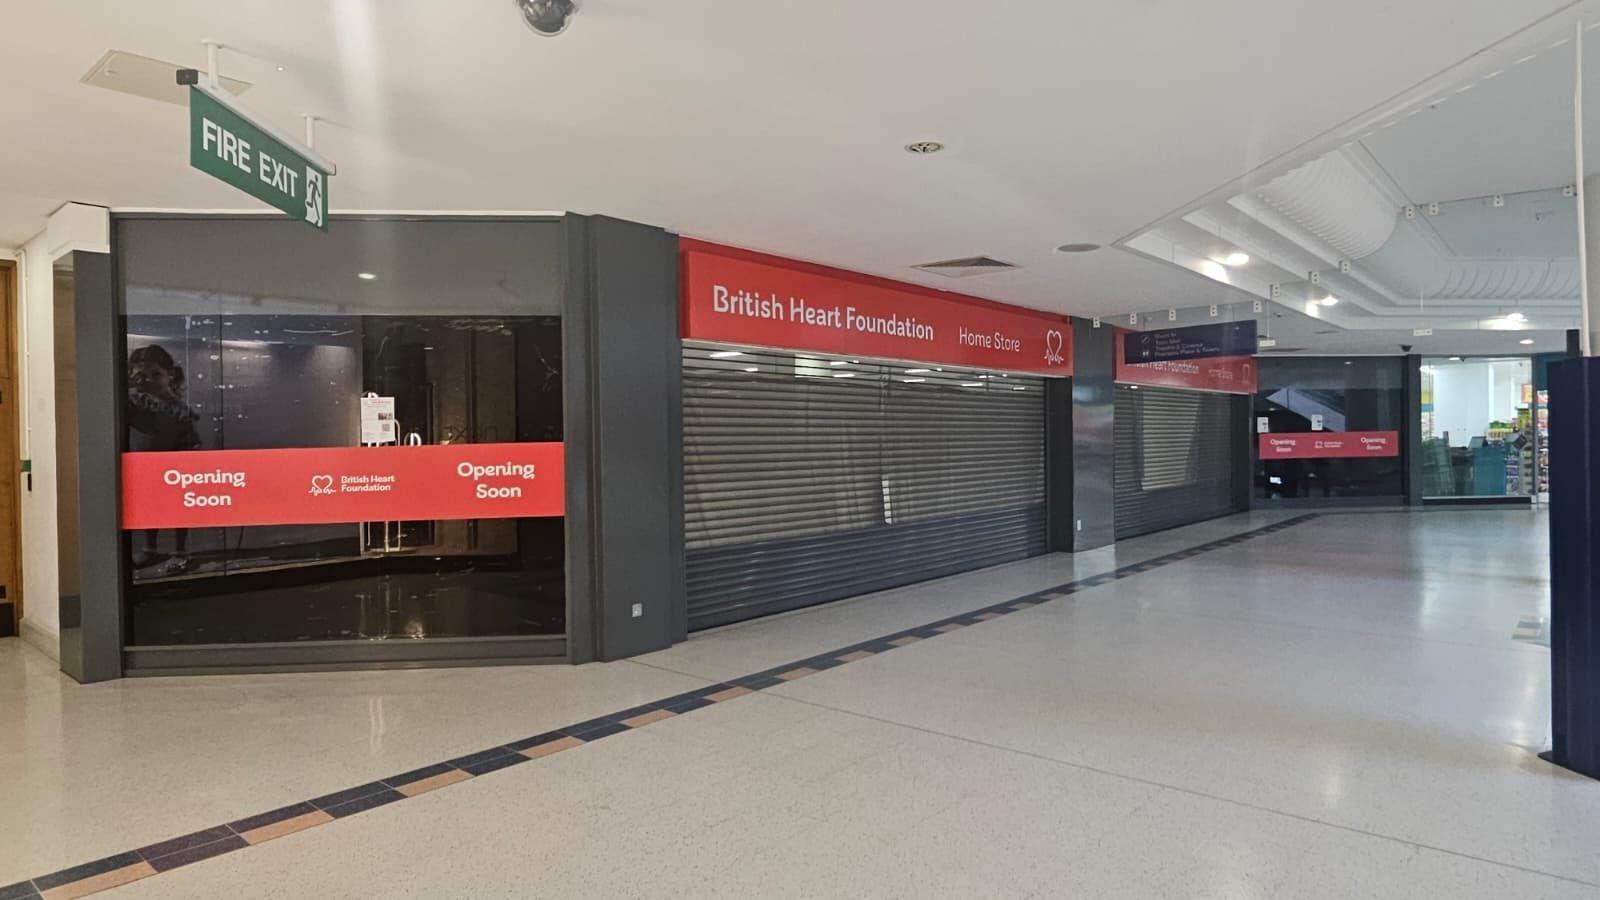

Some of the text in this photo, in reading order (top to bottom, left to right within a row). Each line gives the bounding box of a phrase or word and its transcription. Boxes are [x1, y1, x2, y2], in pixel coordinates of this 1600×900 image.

[202, 117, 298, 198] FIRE EXIT
[713, 285, 934, 341] British Heart Foundation
[959, 326, 1020, 352] Home Store
[164, 469, 246, 488] Opening
[341, 474, 395, 484] British Heart
[457, 461, 535, 480] Opening
[341, 483, 391, 492] Foundation
[476, 483, 522, 499] Soon
[183, 492, 232, 507] Soon
